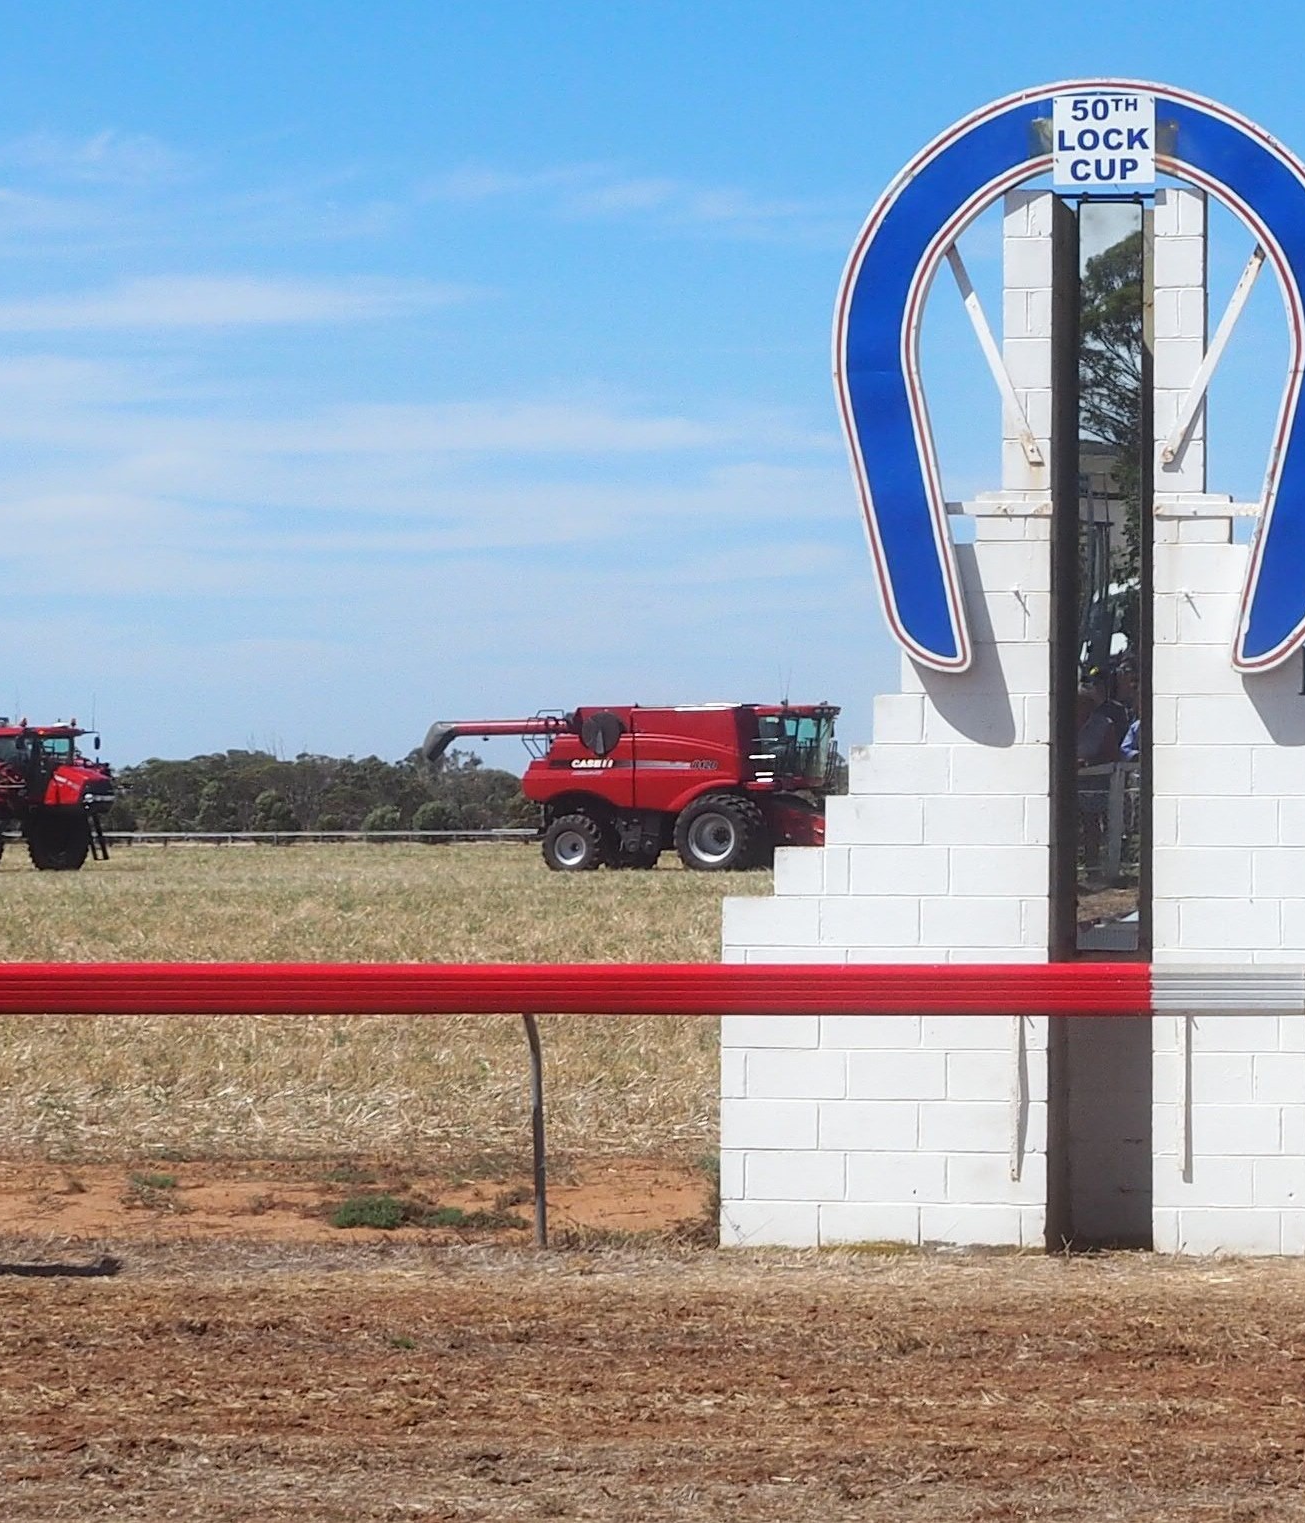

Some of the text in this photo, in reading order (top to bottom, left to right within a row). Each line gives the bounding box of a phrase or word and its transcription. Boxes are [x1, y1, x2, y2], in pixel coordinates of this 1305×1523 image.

[1071, 98, 1138, 121] 50TH
[1058, 128, 1149, 151] LOCK
[1070, 158, 1139, 181] CUP
